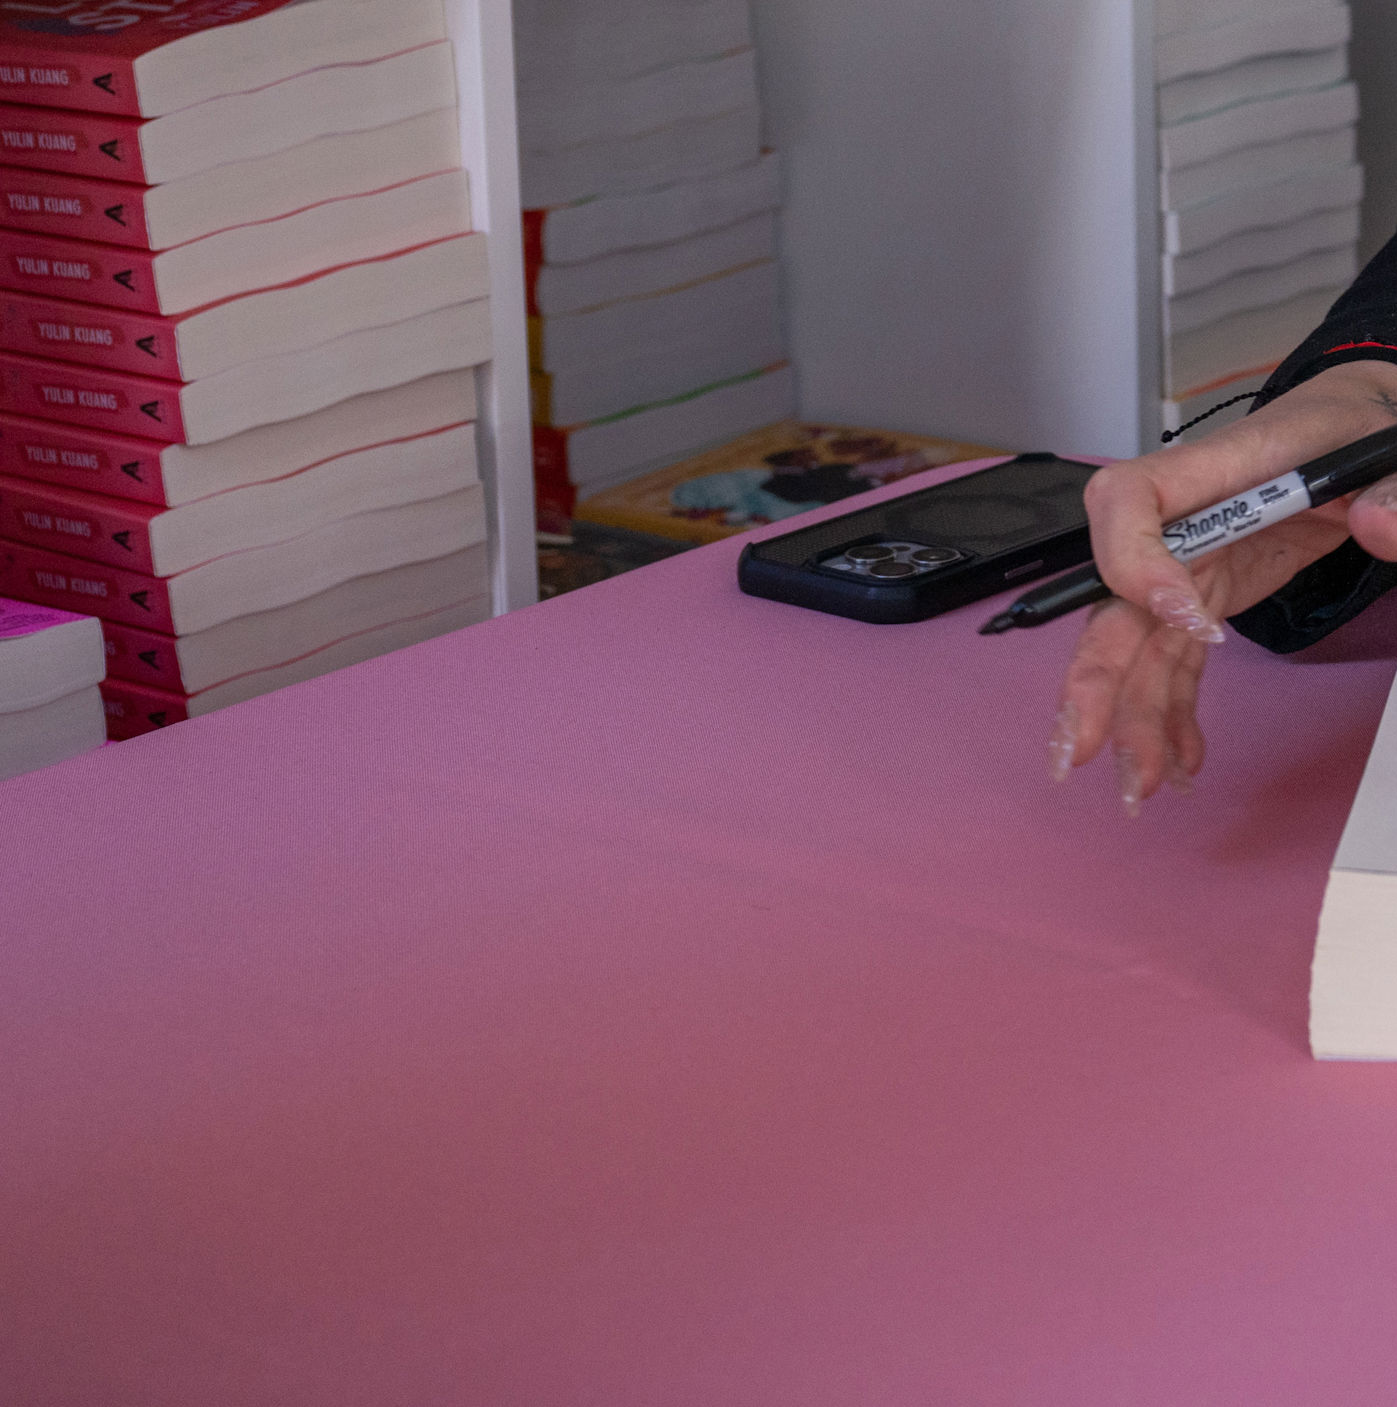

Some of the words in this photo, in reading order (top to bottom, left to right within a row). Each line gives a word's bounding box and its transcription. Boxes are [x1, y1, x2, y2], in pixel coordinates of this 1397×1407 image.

[30, 68, 69, 85] KUANG
[2, 132, 33, 148] YULIN
[38, 134, 76, 152] KUANG
[8, 194, 40, 211] YULIN
[44, 197, 81, 216] KUANG
[16, 257, 48, 275] YULIN
[53, 261, 90, 280] KUANG
[38, 323, 70, 340] YULIN
[74, 327, 113, 346] KUANG
[42, 387, 75, 404] YULIN
[78, 390, 117, 409] KUANG
[25, 445, 57, 462] YULIN
[61, 450, 99, 470] KUANG
[22, 511, 52, 530] YULIN
[55, 516, 91, 537] KUANG
[1163, 501, 1254, 553] Sharpie
[35, 571, 67, 591] YULIN
[71, 577, 107, 597] KUANG
